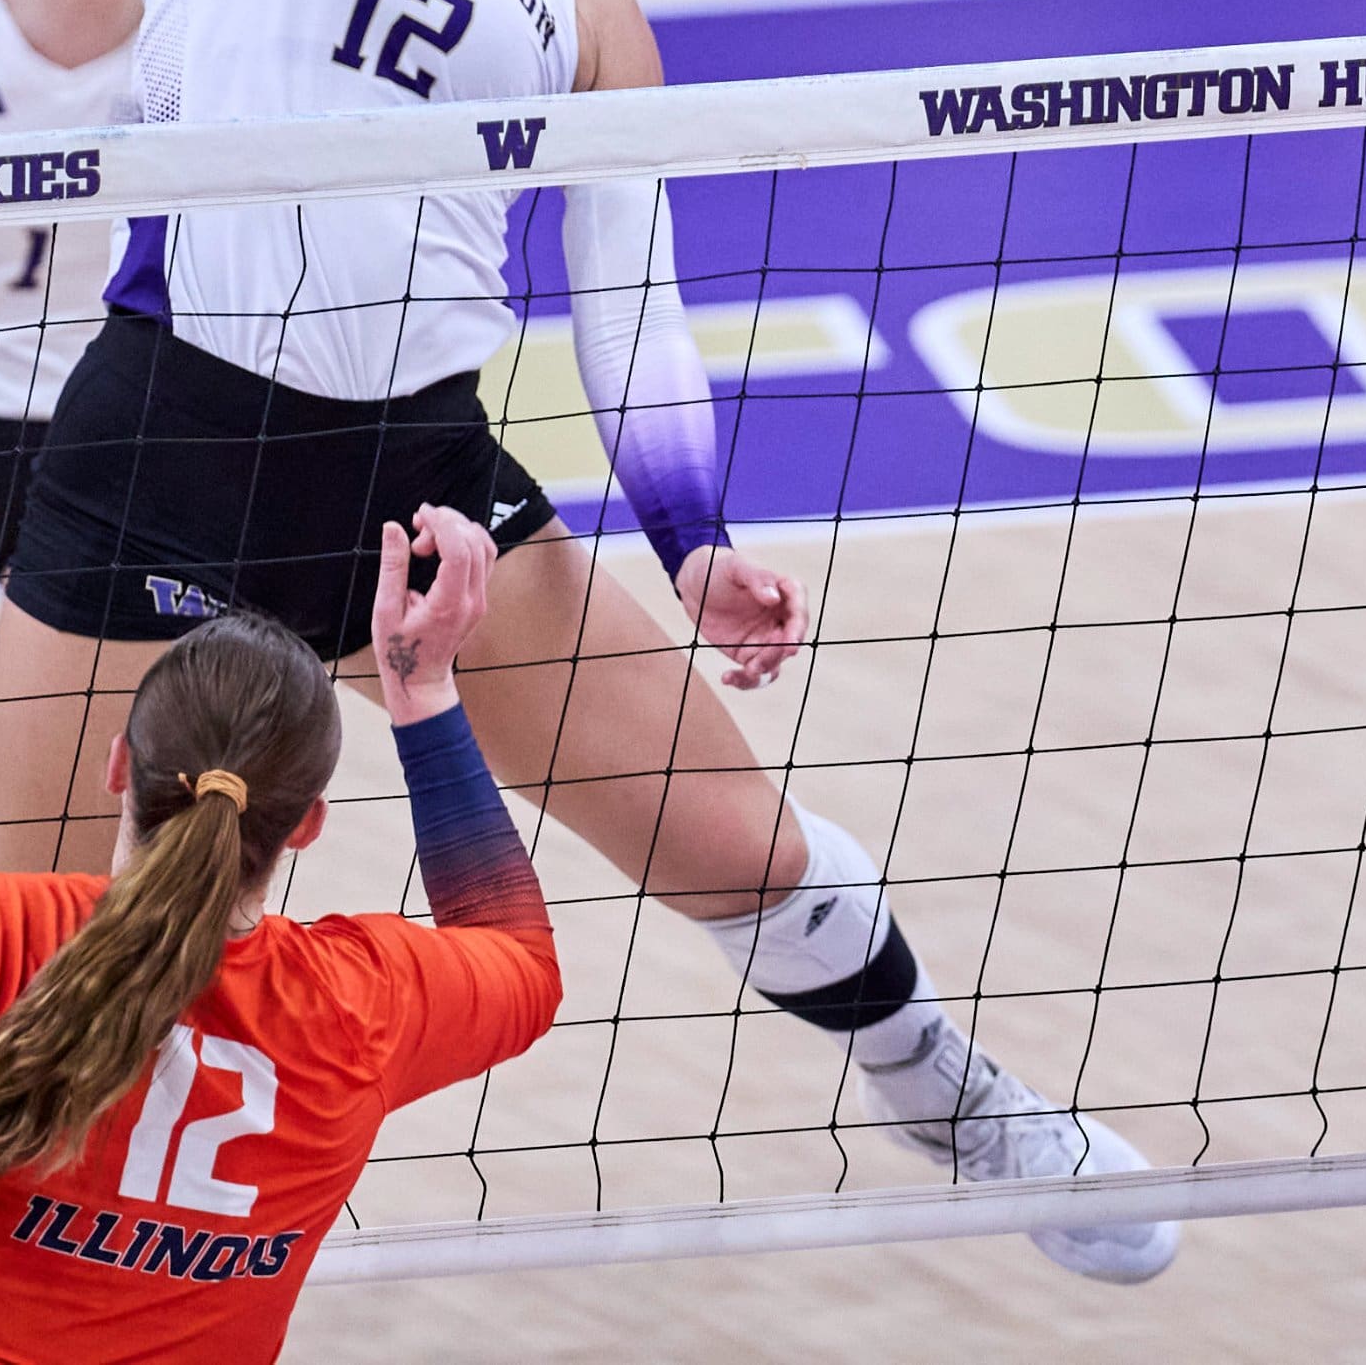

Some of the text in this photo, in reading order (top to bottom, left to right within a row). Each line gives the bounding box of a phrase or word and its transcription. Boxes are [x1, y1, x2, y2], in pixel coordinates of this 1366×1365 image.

[919, 64, 1294, 137] WASHINGTON
[477, 116, 547, 171] W
[117, 1023, 279, 1218] 12
[10, 1193, 306, 1283] ILLINOIS
